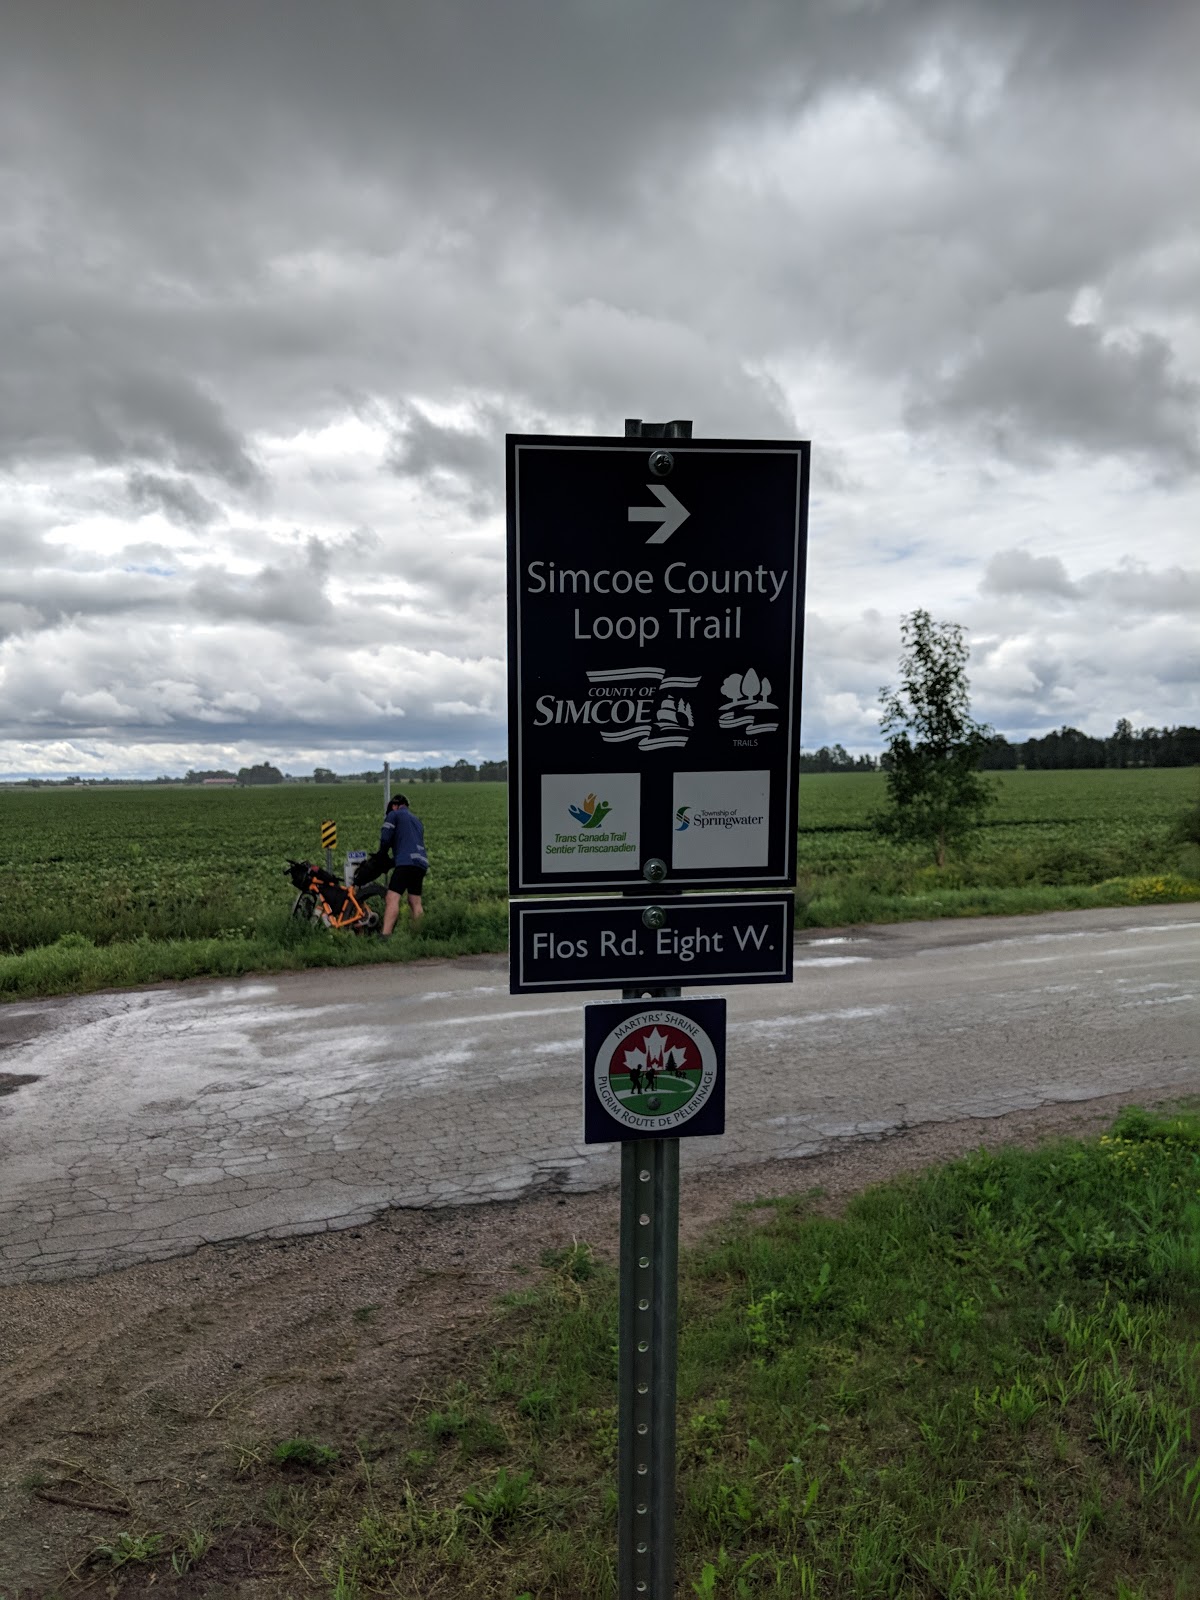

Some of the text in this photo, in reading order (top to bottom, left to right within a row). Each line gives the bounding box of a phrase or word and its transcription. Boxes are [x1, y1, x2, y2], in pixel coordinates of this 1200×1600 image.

[527, 561, 788, 602] Simcoe County
[574, 606, 741, 648] Loop Trail
[588, 686, 656, 698] COUNTY OF
[533, 694, 654, 726] SIMCOE
[732, 738, 758, 747] TRAILS
[693, 814, 764, 829] Springwater
[701, 808, 738, 818] Township of
[555, 832, 627, 843] Trans Canada Trail
[545, 843, 636, 854] Sentier Transcanadien
[533, 924, 775, 962] Flos Rd. Eight W.
[614, 1013, 700, 1039] MARTYRS' SHRINE
[598, 1075, 622, 1115] PILGRIM
[620, 1110, 655, 1127] ROUTE
[658, 1116, 672, 1127] DE
